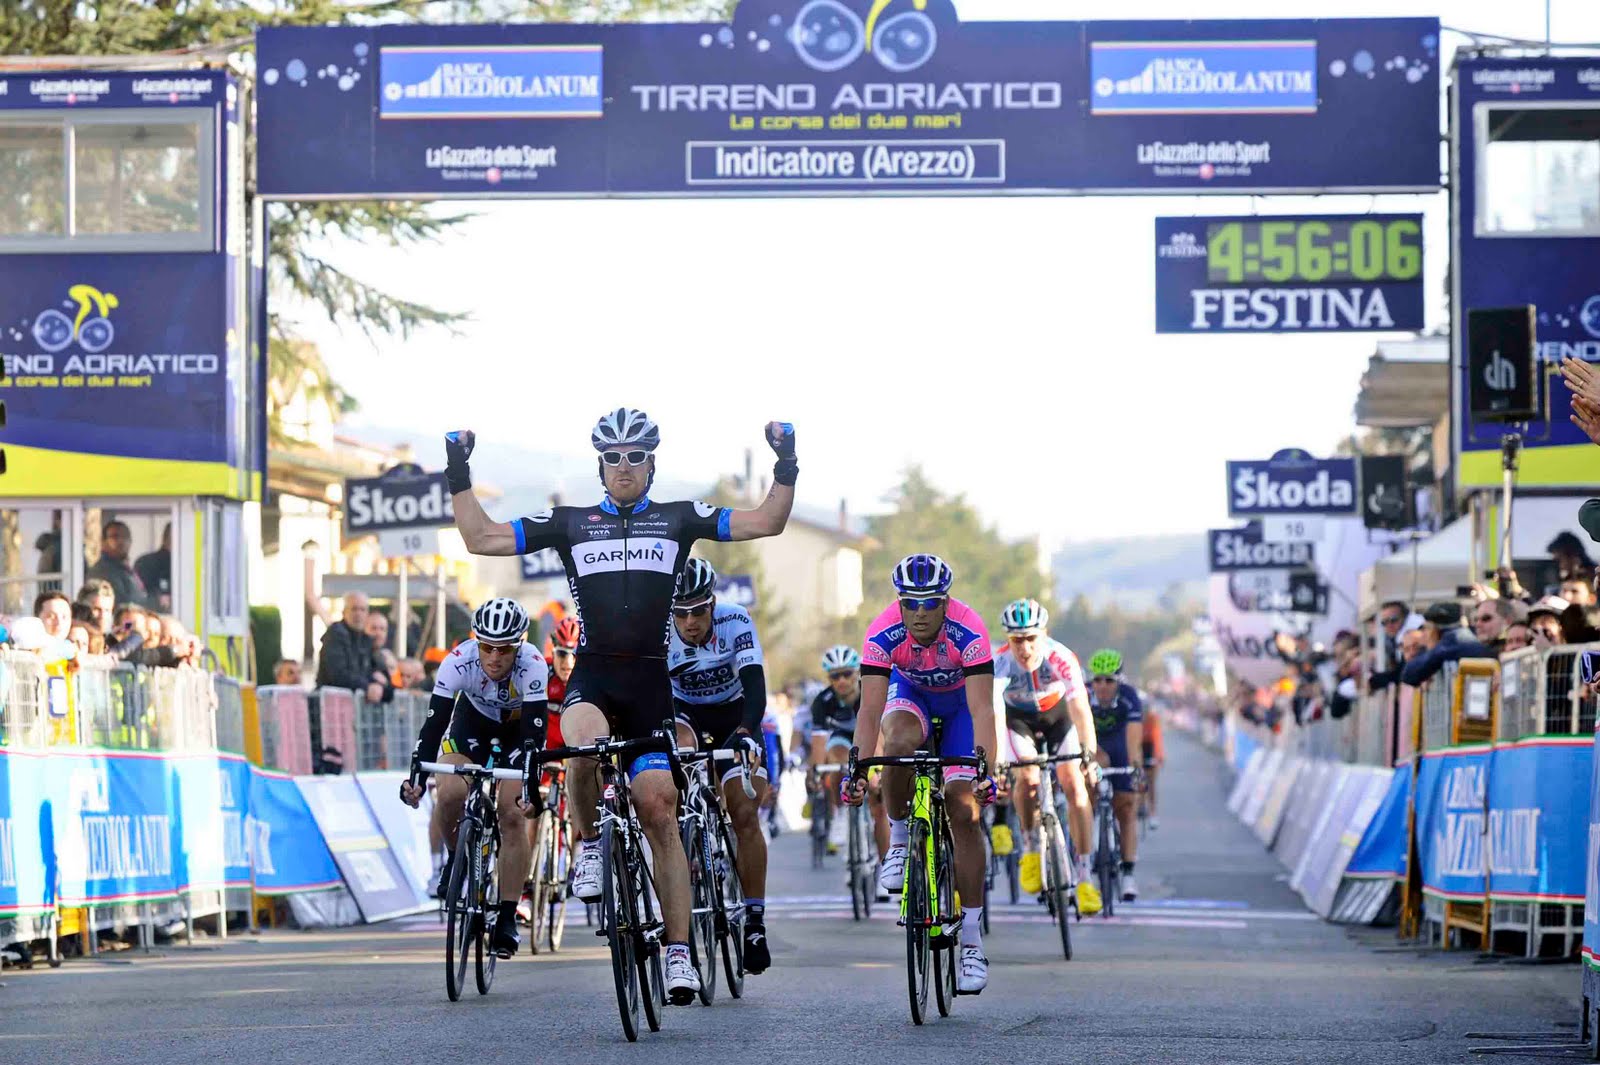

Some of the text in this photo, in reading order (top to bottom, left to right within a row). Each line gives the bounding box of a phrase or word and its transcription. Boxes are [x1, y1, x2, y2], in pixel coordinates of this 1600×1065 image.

[443, 75, 599, 98] MEDIOLANUM
[1155, 71, 1313, 94] MEDIOLANUM
[631, 82, 1062, 110] TIRRENO ADRIATICO
[729, 112, 962, 130] La corsa dei due mari
[715, 144, 976, 181] Indicatore (Arezzo)
[1208, 220, 1420, 283] 4:56:06
[1191, 288, 1395, 329] FESTINA
[63, 354, 219, 374] ADRIATICO
[1235, 467, 1352, 508] Škoda
[583, 548, 664, 564] GARMIN
